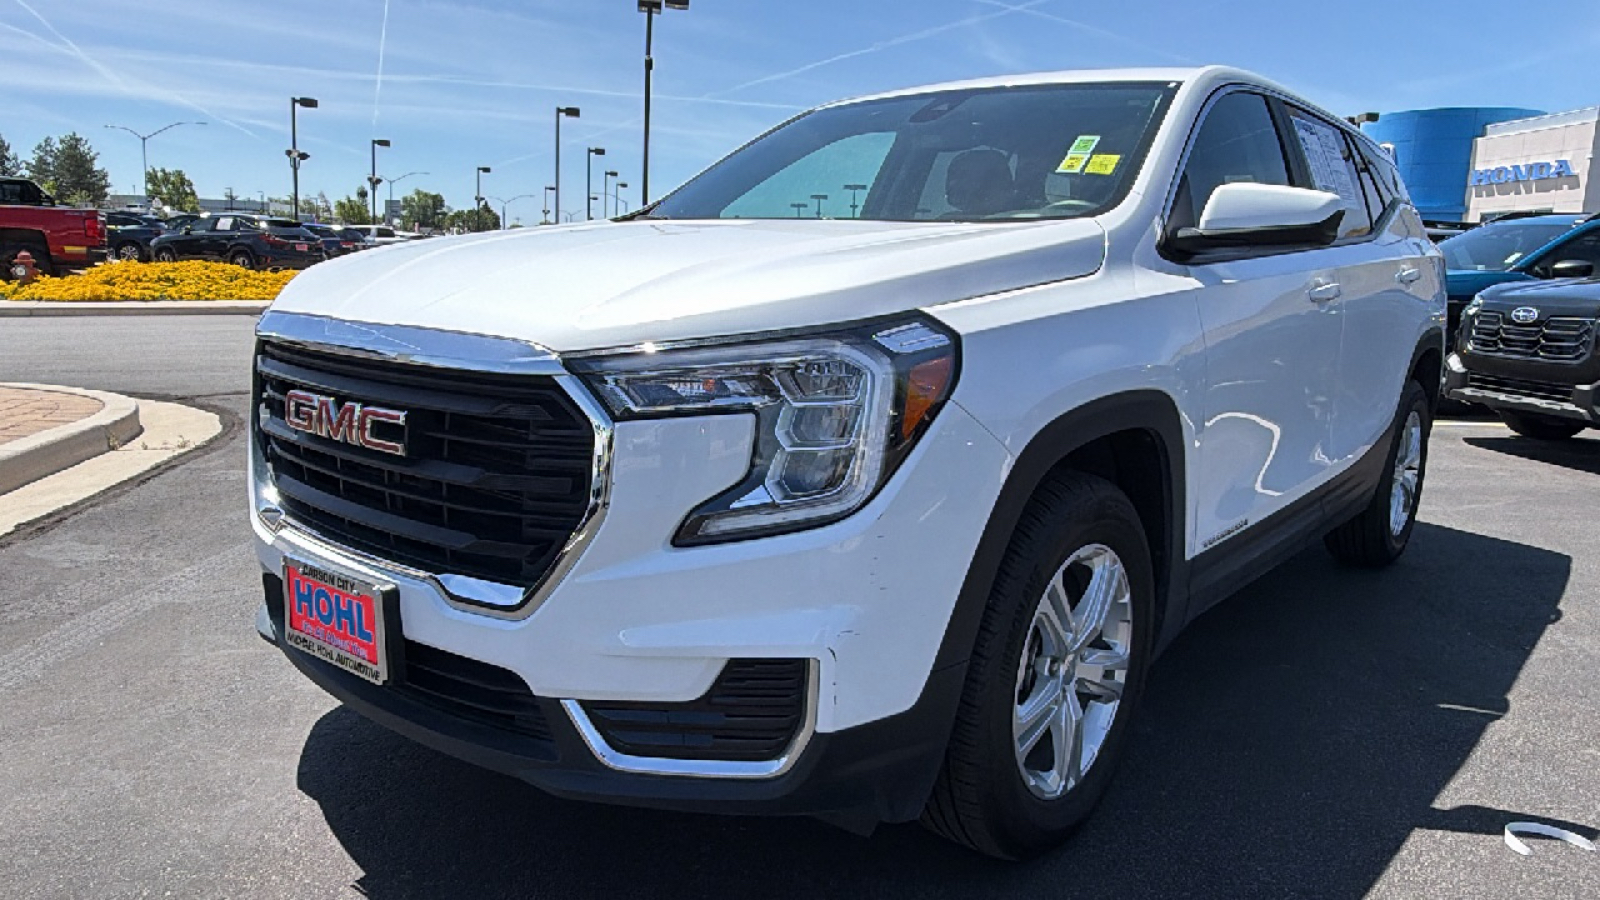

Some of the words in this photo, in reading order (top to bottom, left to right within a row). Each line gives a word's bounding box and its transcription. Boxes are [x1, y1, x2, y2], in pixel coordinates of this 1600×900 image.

[1470, 159, 1573, 185] HONDA
[285, 389, 408, 456] GMC
[302, 564, 334, 585] CARSON
[337, 577, 356, 592] CITY
[294, 578, 373, 643] HOHL
[287, 631, 316, 652] MICHAEL
[316, 644, 334, 660] HOHL
[335, 653, 381, 681] AUTOMOTIVE
